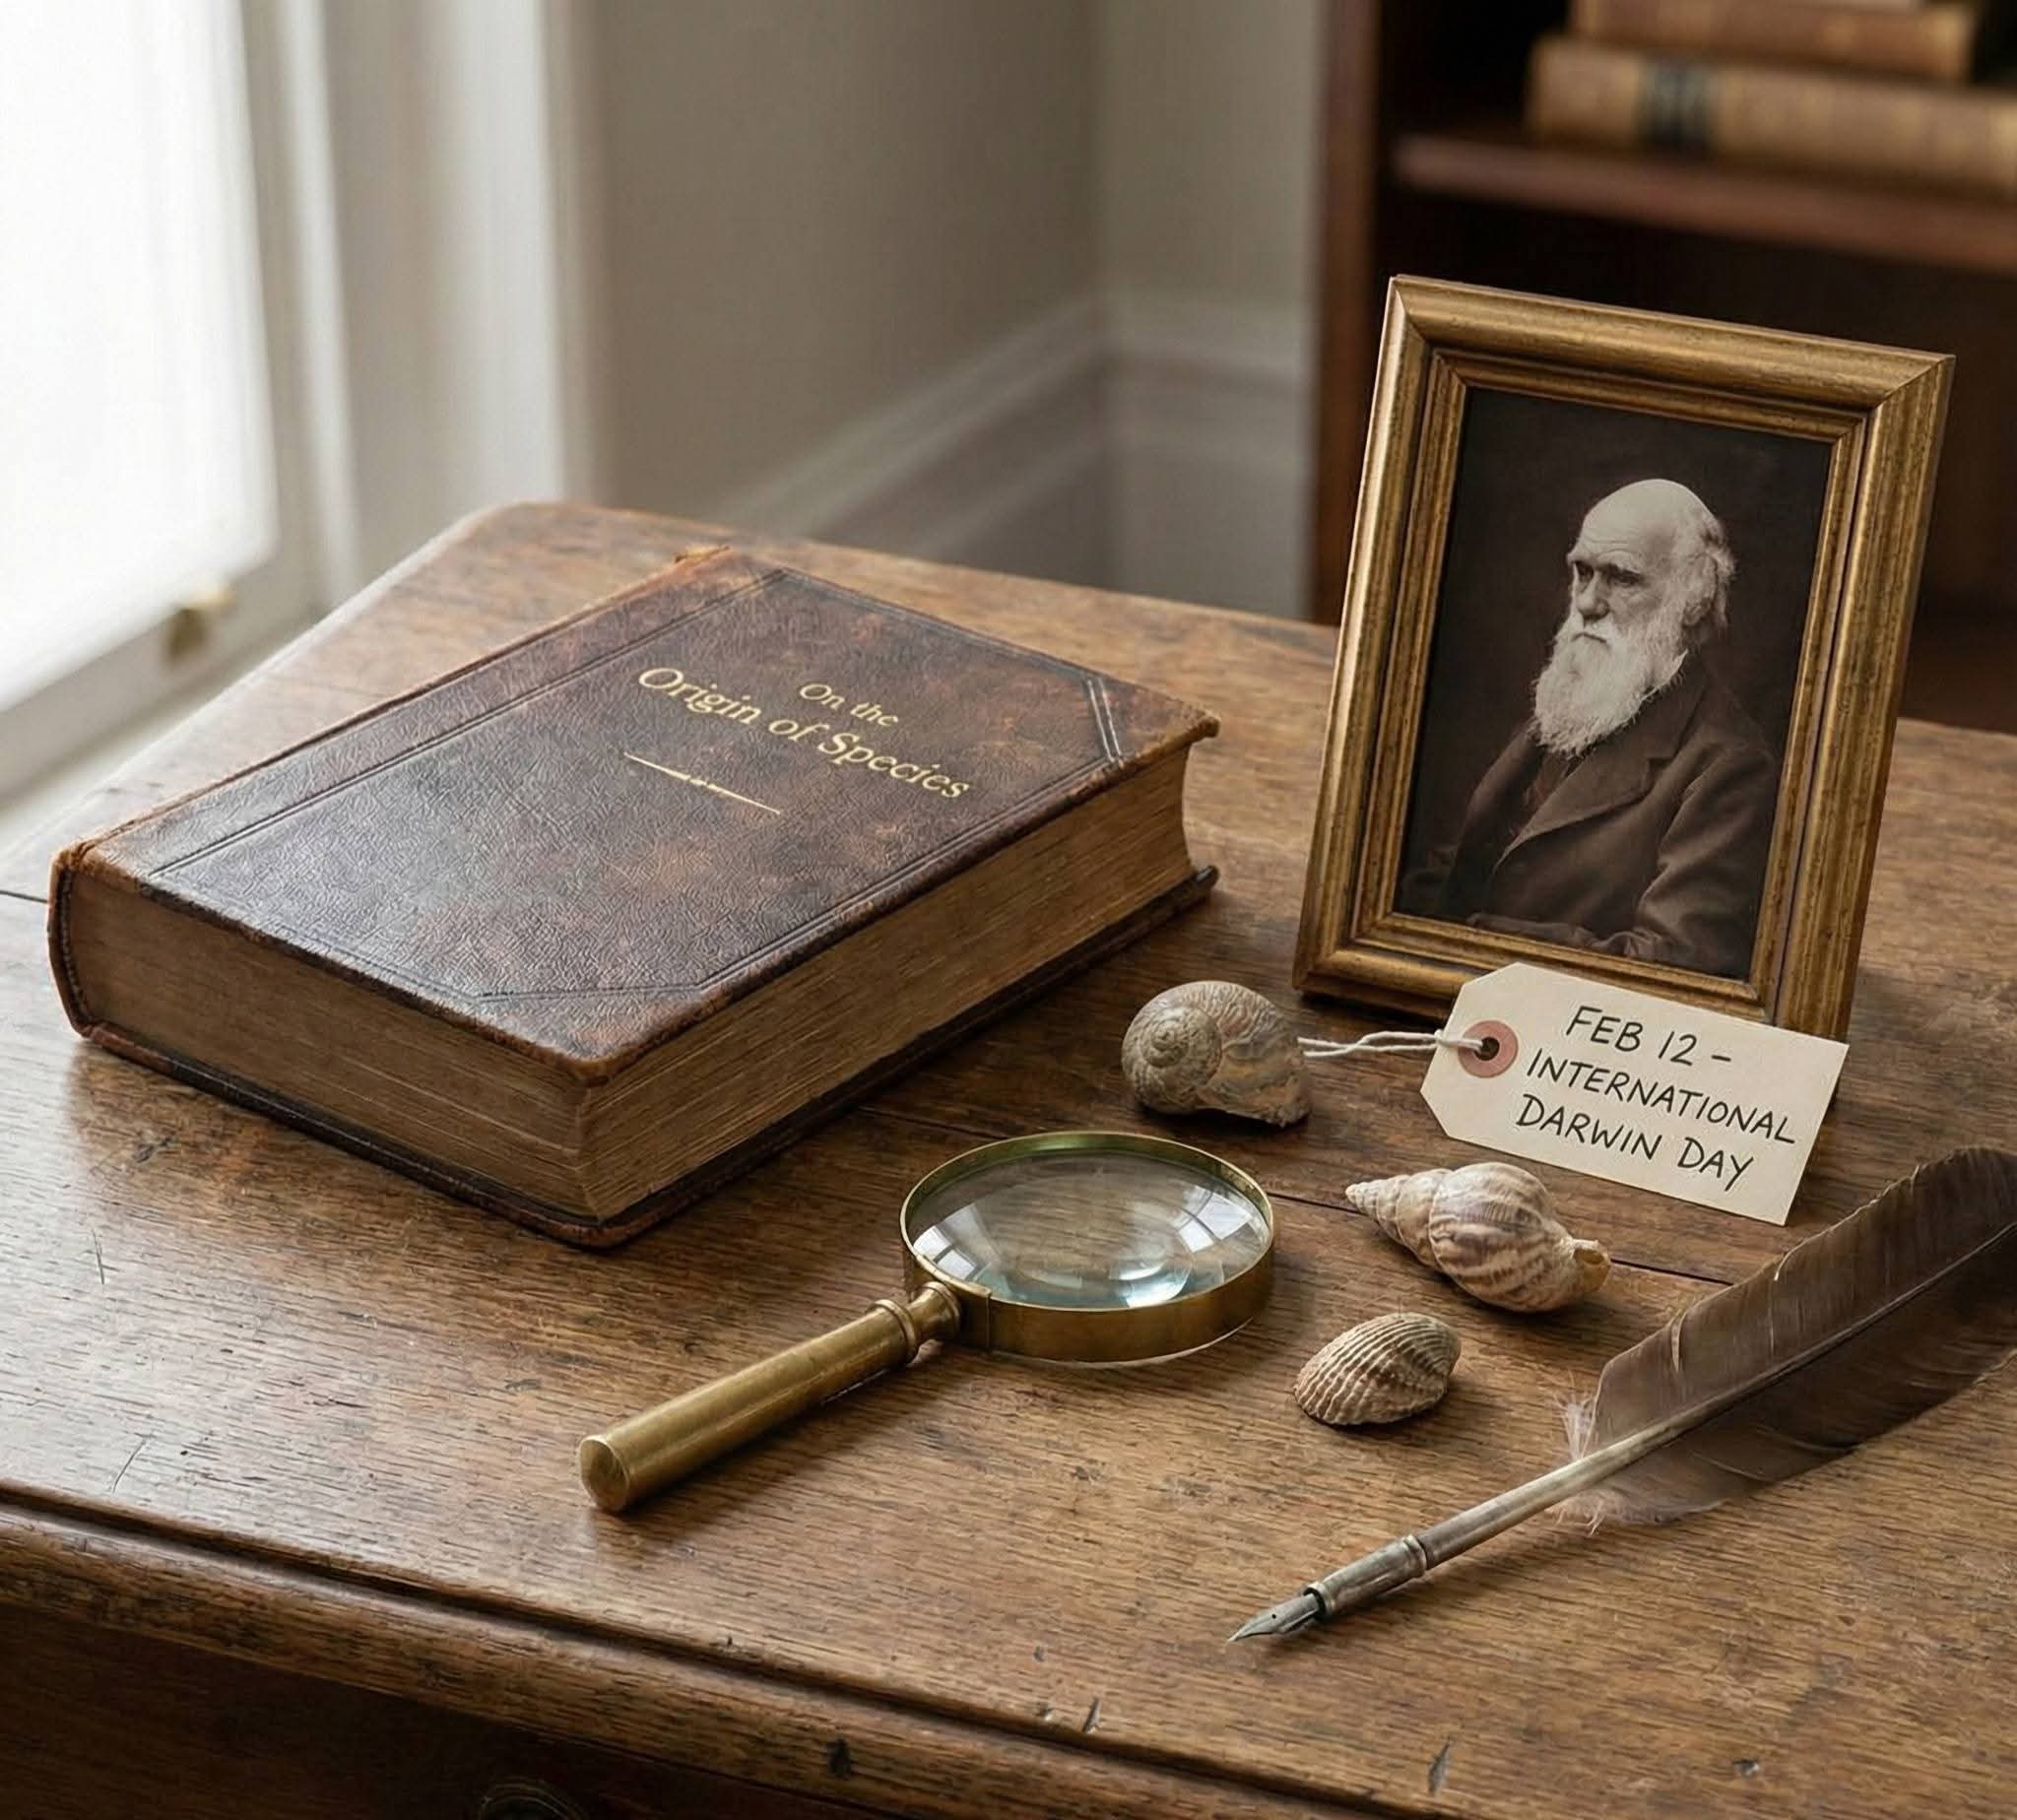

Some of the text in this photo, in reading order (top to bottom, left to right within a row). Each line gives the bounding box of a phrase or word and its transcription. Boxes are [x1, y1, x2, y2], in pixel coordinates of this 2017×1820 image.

[639, 668, 969, 798] Origin of Species
[800, 683, 898, 727] On the
[1566, 1006, 1643, 1052] FEB
[1658, 1031, 1698, 1066] 12
[1516, 1094, 1754, 1191] DARWIN DAY
[1527, 1049, 1795, 1144] INTERNATIONAL
